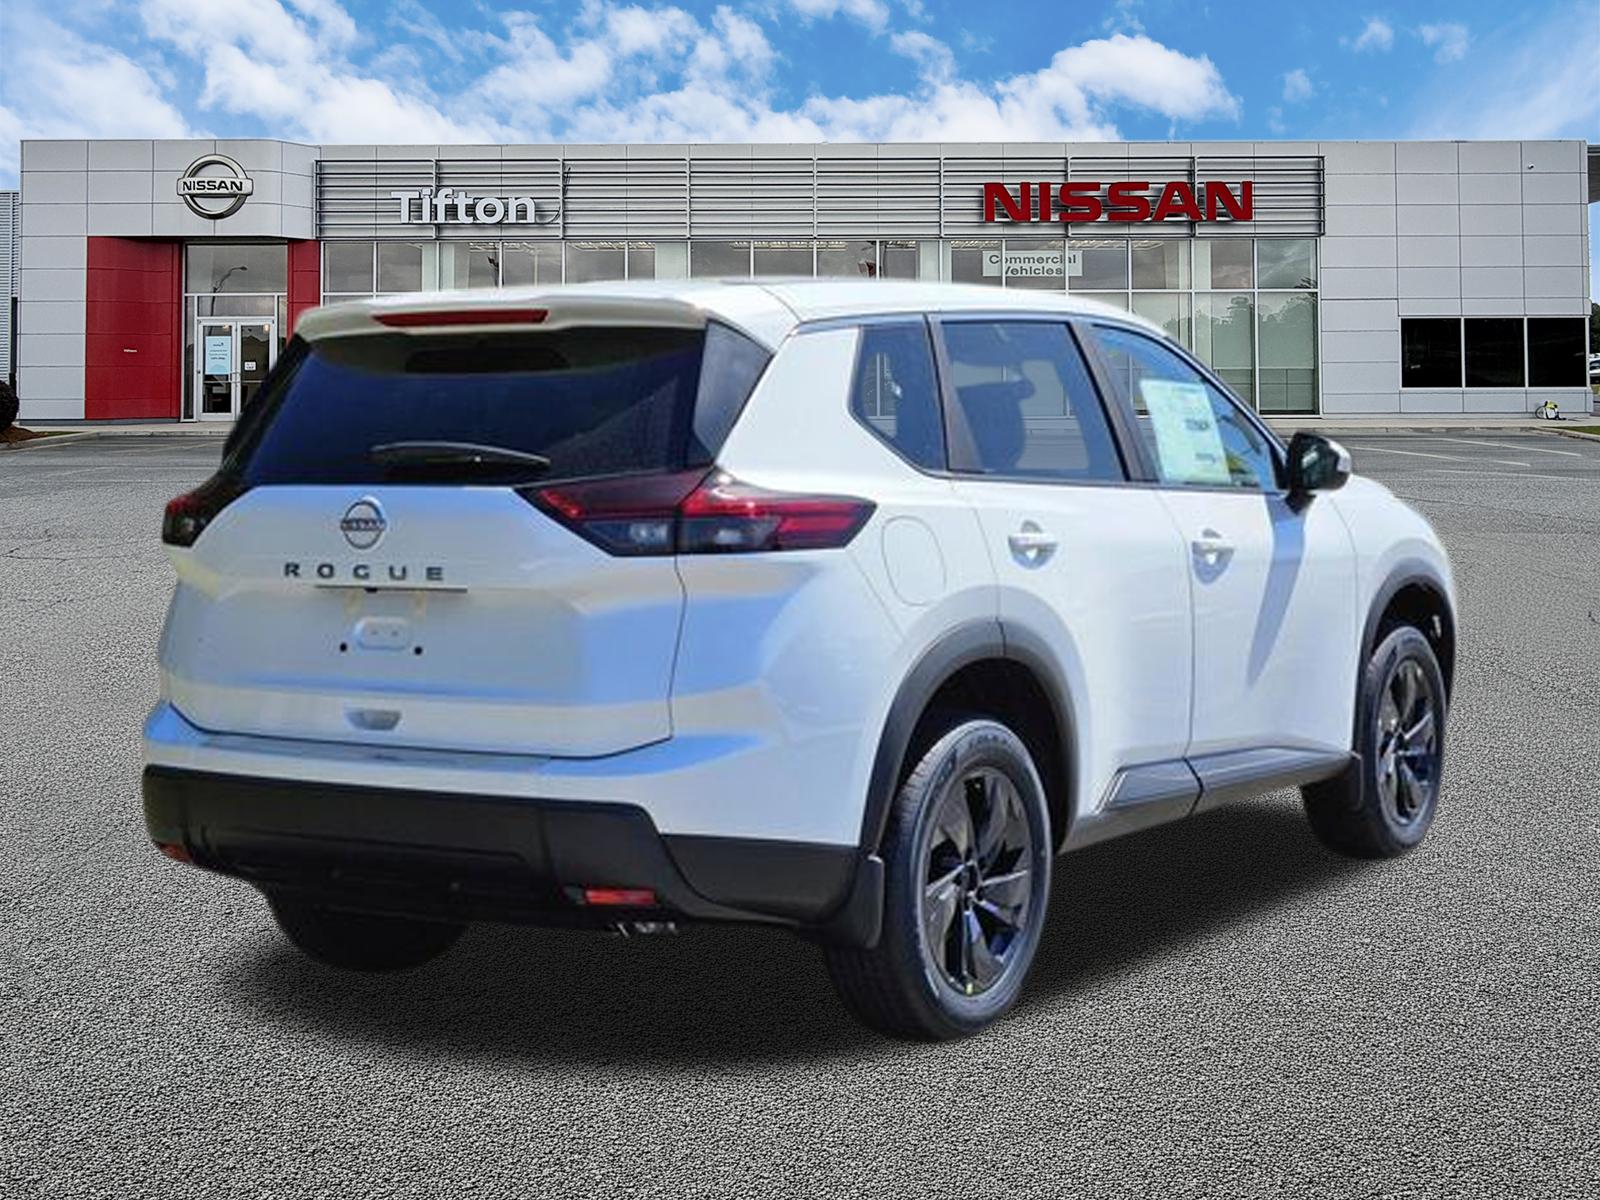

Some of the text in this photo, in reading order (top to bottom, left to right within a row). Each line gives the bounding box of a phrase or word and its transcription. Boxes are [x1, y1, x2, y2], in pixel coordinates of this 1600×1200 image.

[183, 181, 243, 191] NISSAN
[390, 188, 536, 224] Tifton
[984, 181, 1253, 222] NISSAN
[284, 562, 443, 581] ROGUE
